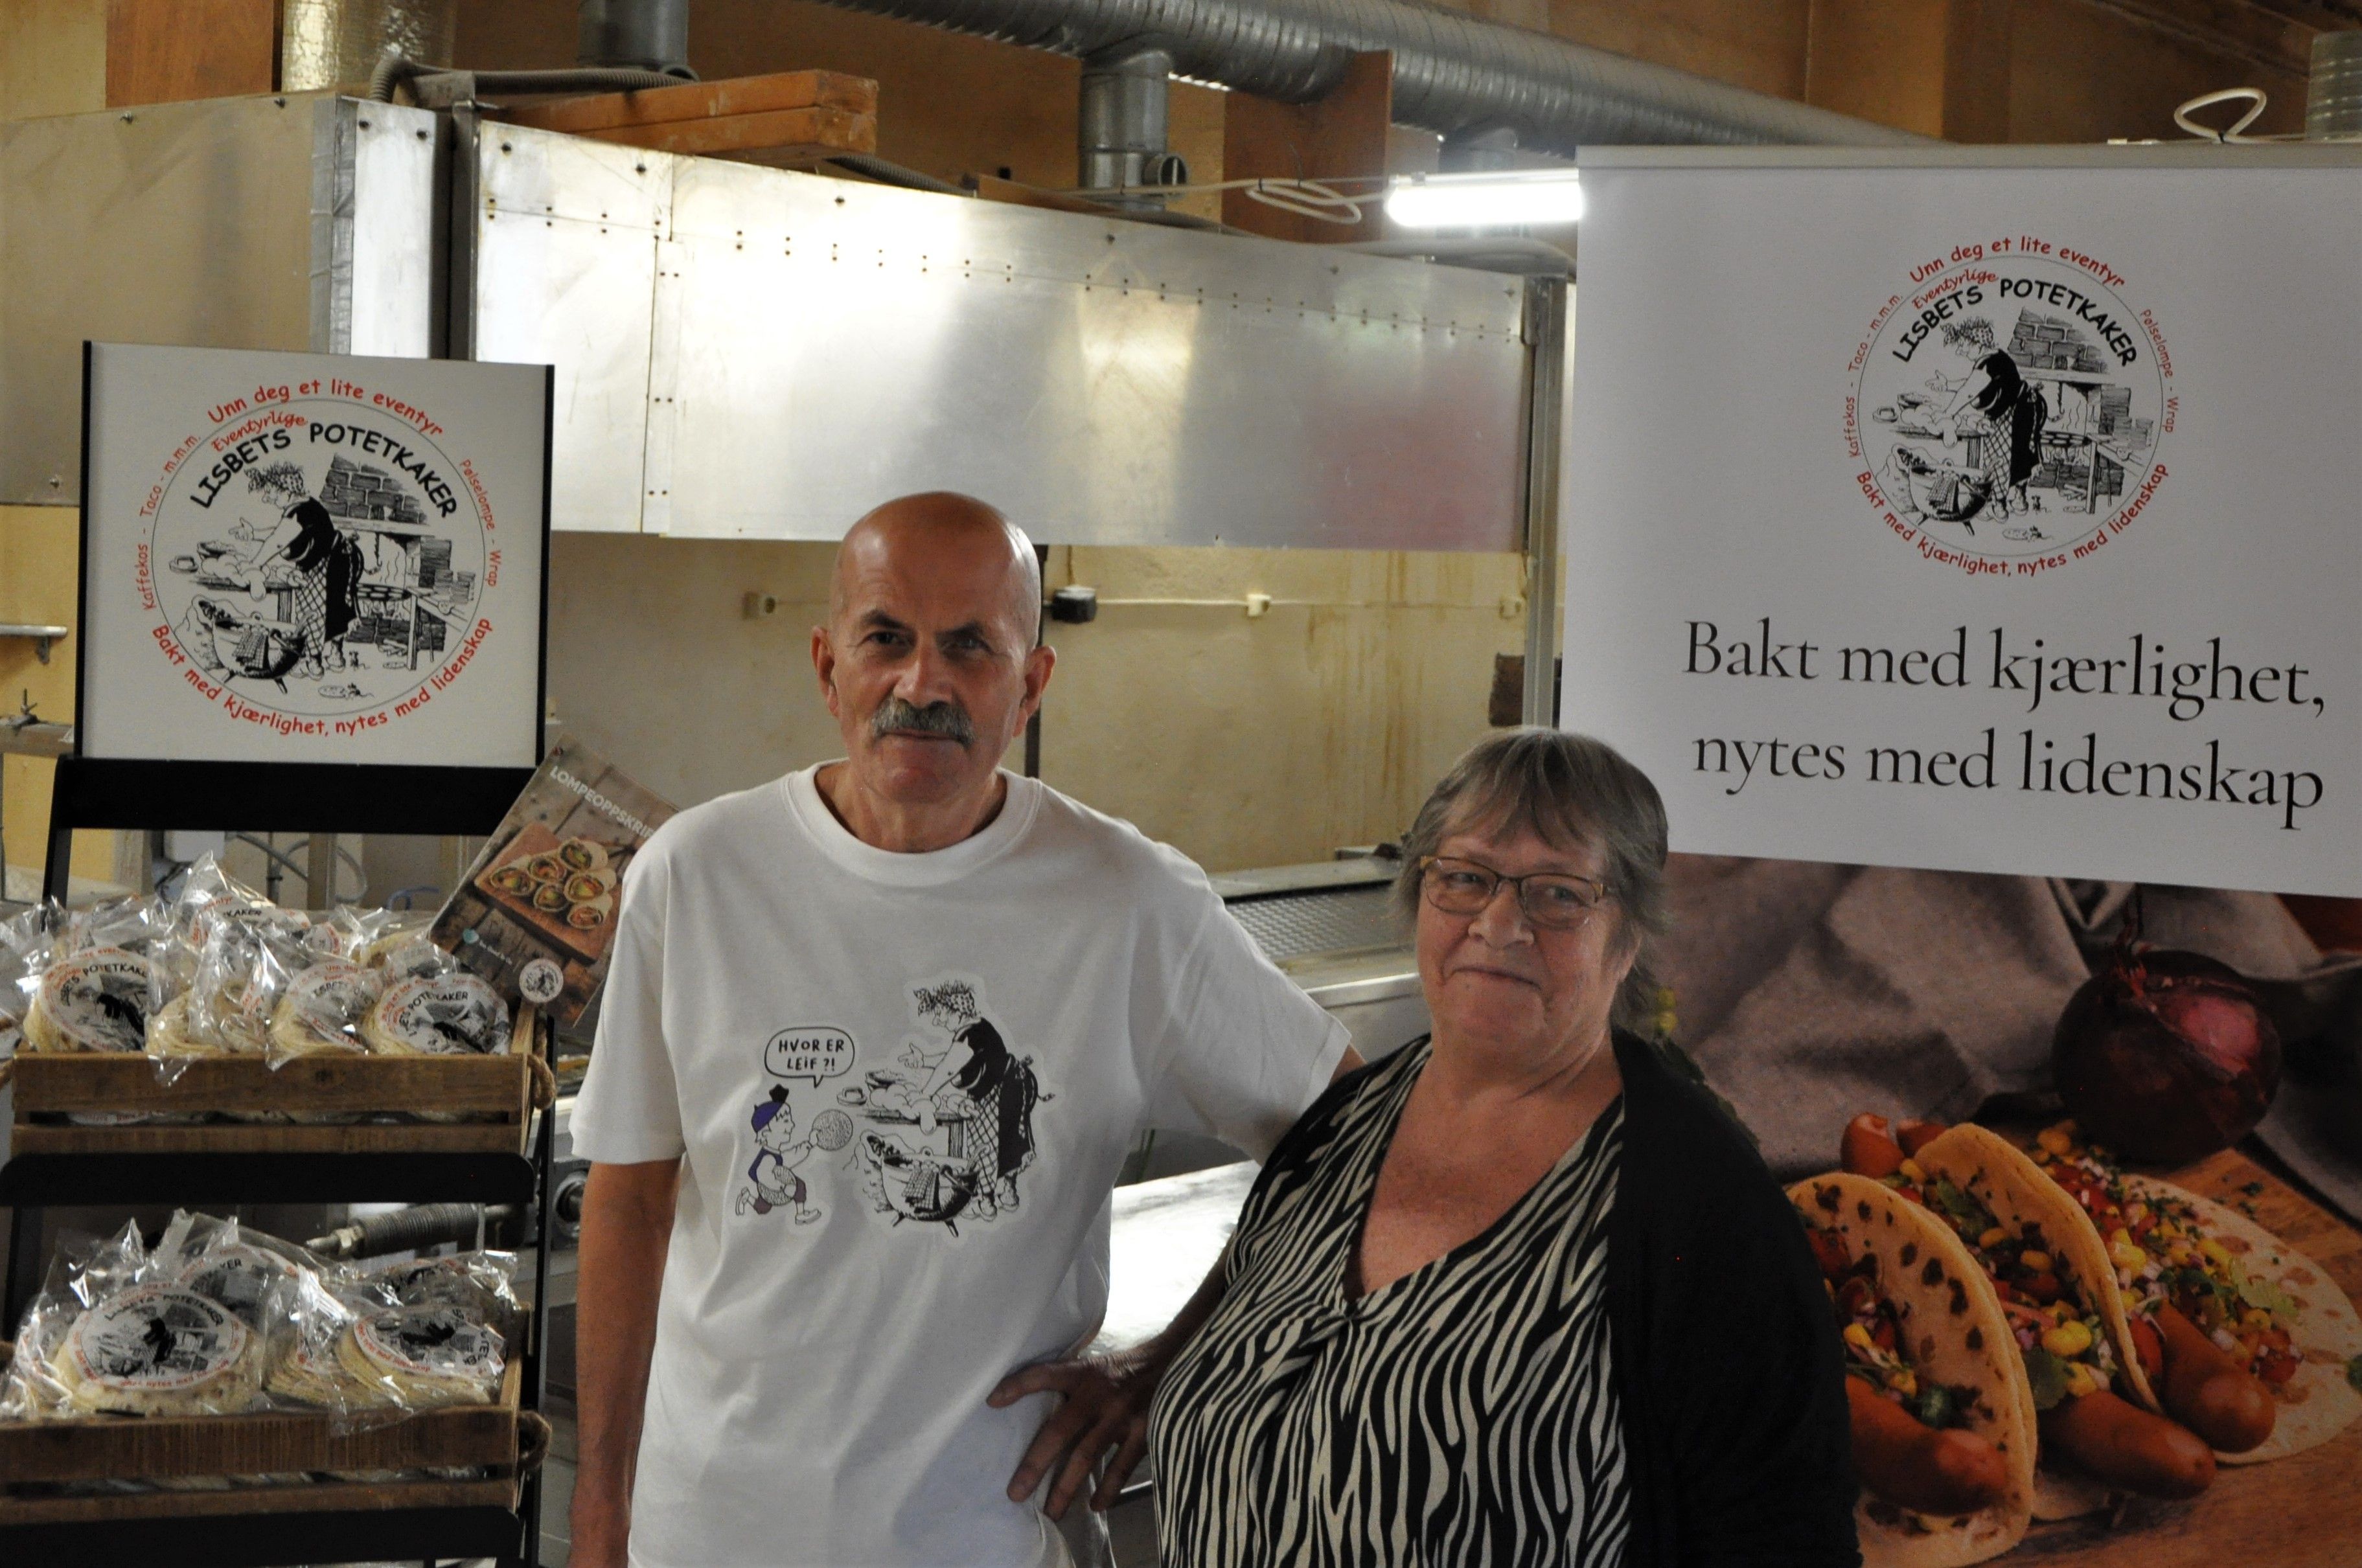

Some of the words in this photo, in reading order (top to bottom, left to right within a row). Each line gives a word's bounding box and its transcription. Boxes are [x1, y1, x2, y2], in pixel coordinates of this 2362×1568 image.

[1910, 259, 1945, 282] Unn
[1951, 244, 1983, 261] deg
[1991, 237, 2011, 253] et
[2021, 236, 2051, 255] lite
[2059, 247, 2126, 288] eventyr
[1911, 268, 1999, 310] Eventyrlige
[1892, 286, 1983, 362] LISBETS
[2000, 278, 2137, 367] POTETKAKER
[1848, 341, 1868, 371] Taco
[208, 398, 247, 423] Unn
[254, 386, 290, 403] deg
[299, 379, 321, 394] et
[331, 378, 364, 399] lite
[373, 392, 443, 437] eventyr
[211, 411, 308, 453] Eventyrlige
[1843, 396, 1861, 458] Kaffekos
[2162, 396, 2179, 433] Wrap
[190, 429, 291, 508] LISBETS
[310, 422, 457, 517] POTETKAKER
[140, 485, 161, 517] Taco
[1857, 471, 1885, 509] Bakt
[1883, 512, 1917, 541] med
[1917, 535, 2011, 576] kjærlighet,
[2018, 552, 2067, 576] nytes
[2073, 530, 2109, 560] med
[2108, 463, 2169, 535] lidenskap
[135, 543, 157, 611] Kaffekos
[485, 550, 501, 587] Wrap
[152, 624, 186, 666] Bakt
[184, 668, 222, 700] med
[224, 694, 328, 736] kjærlighet,
[336, 711, 388, 736] nytes
[395, 688, 431, 718] med
[431, 618, 494, 690] lidenskap
[1684, 617, 1819, 681] Bakt
[1839, 626, 1970, 687] med
[1988, 627, 2325, 722] kjærlighet,
[1692, 736, 1846, 795] nytes
[1866, 728, 1999, 790] med
[2019, 728, 2324, 830] lidenskap
[779, 1039, 820, 1053] HVOR
[827, 1040, 844, 1052] ER
